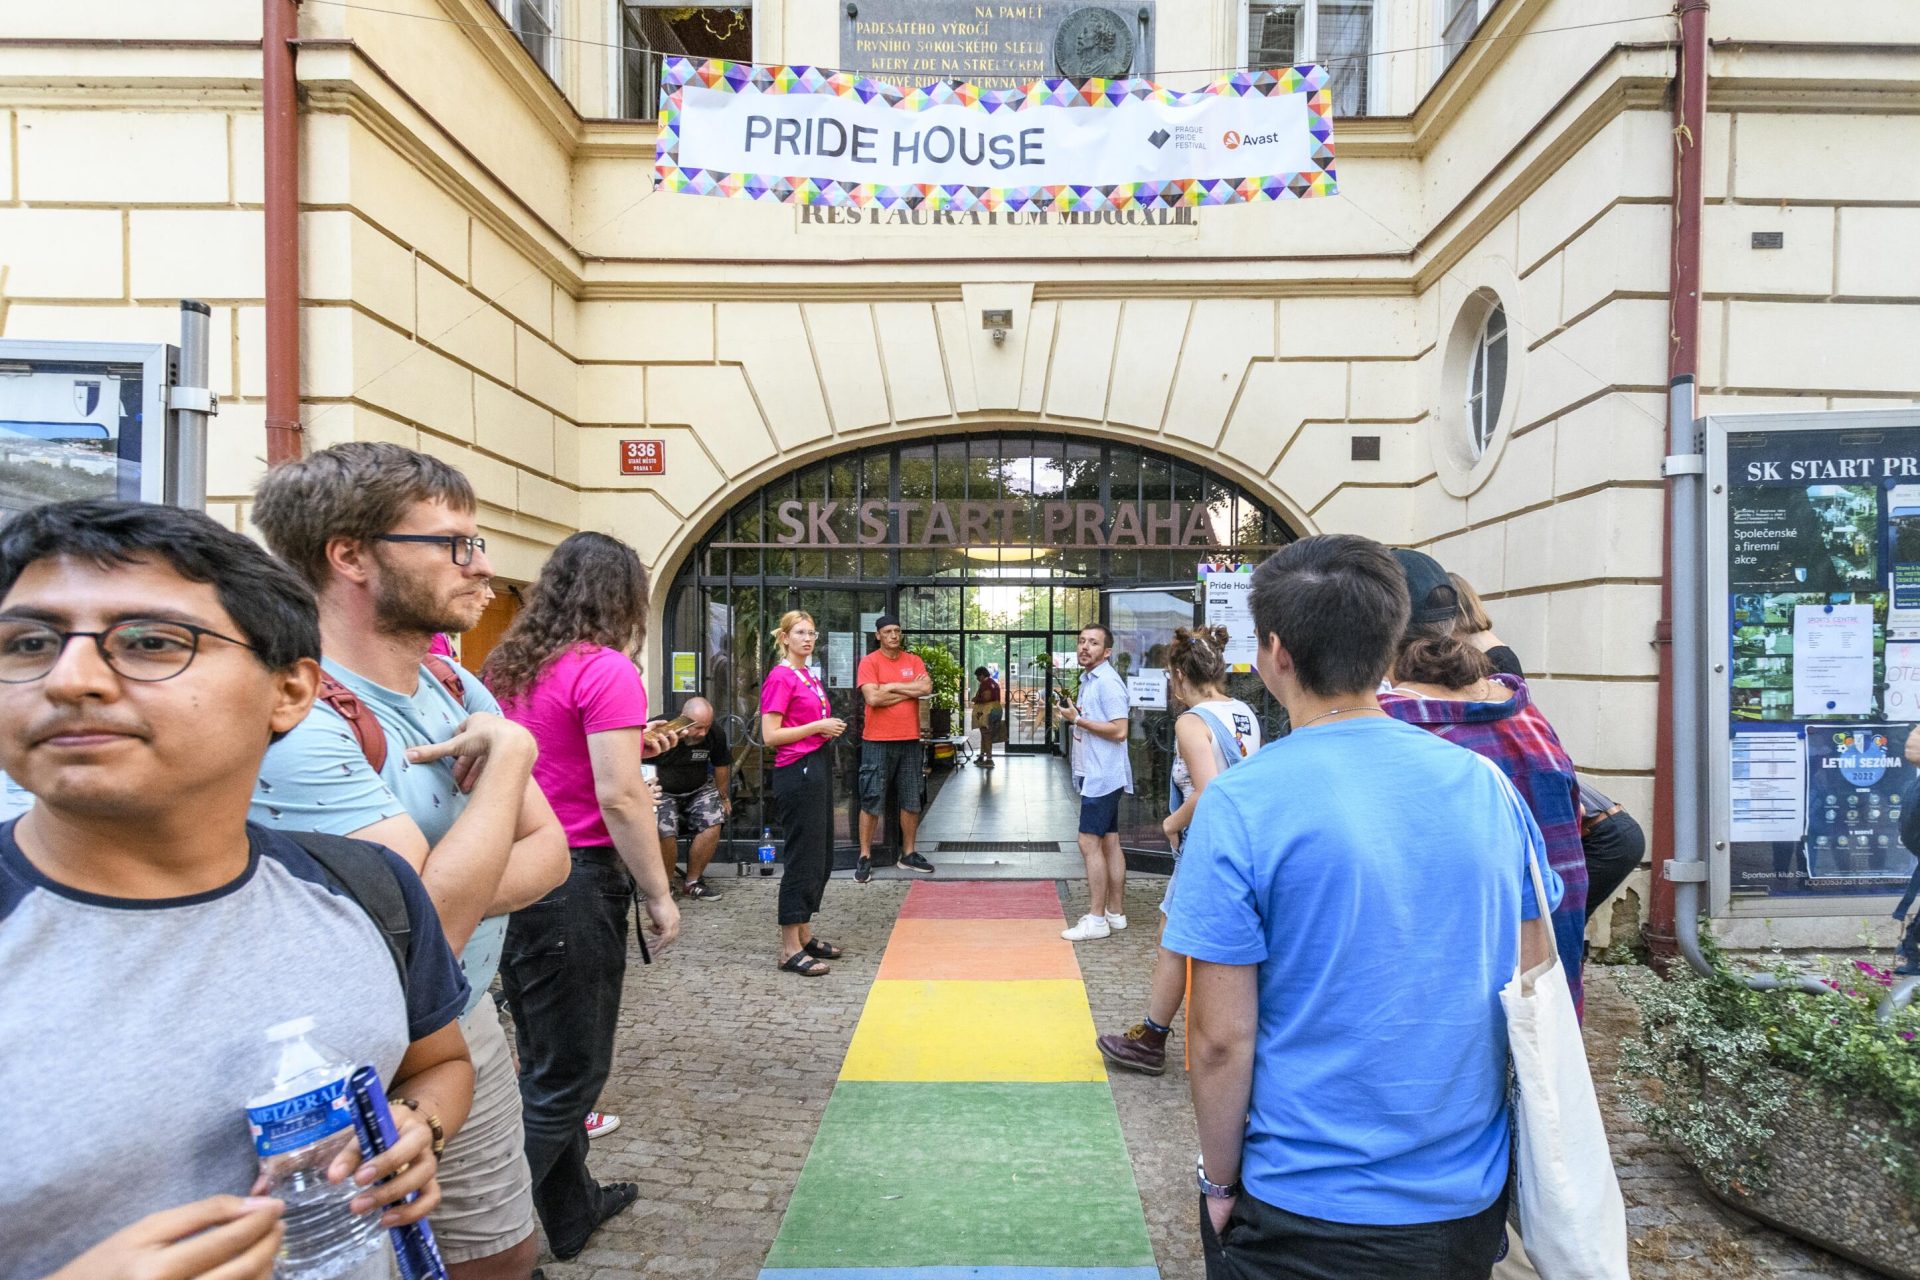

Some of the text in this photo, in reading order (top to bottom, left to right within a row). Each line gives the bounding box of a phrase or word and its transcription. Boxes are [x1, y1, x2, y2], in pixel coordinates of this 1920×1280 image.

[975, 6, 993, 18] NA
[913, 58, 937, 71] ZDE
[942, 58, 960, 71] NA
[1175, 126, 1204, 134] PRAGUE
[745, 115, 1045, 170] PRIDE HOUSE
[1242, 132, 1279, 146] Avast
[1175, 142, 1207, 150] FESTIVAL
[628, 443, 656, 457] 336
[1747, 457, 1920, 481] SK START PR
[777, 500, 1220, 546] SK START PRAHA
[1734, 528, 1798, 540] Společenské
[1742, 541, 1780, 552] firemní
[1734, 555, 1757, 564] akce
[1210, 581, 1253, 590] Pride Hou
[1822, 754, 1902, 768] LETNÍ SEZÓNA
[1852, 772, 1874, 780] 2022
[1742, 871, 1777, 879] Sportovní
